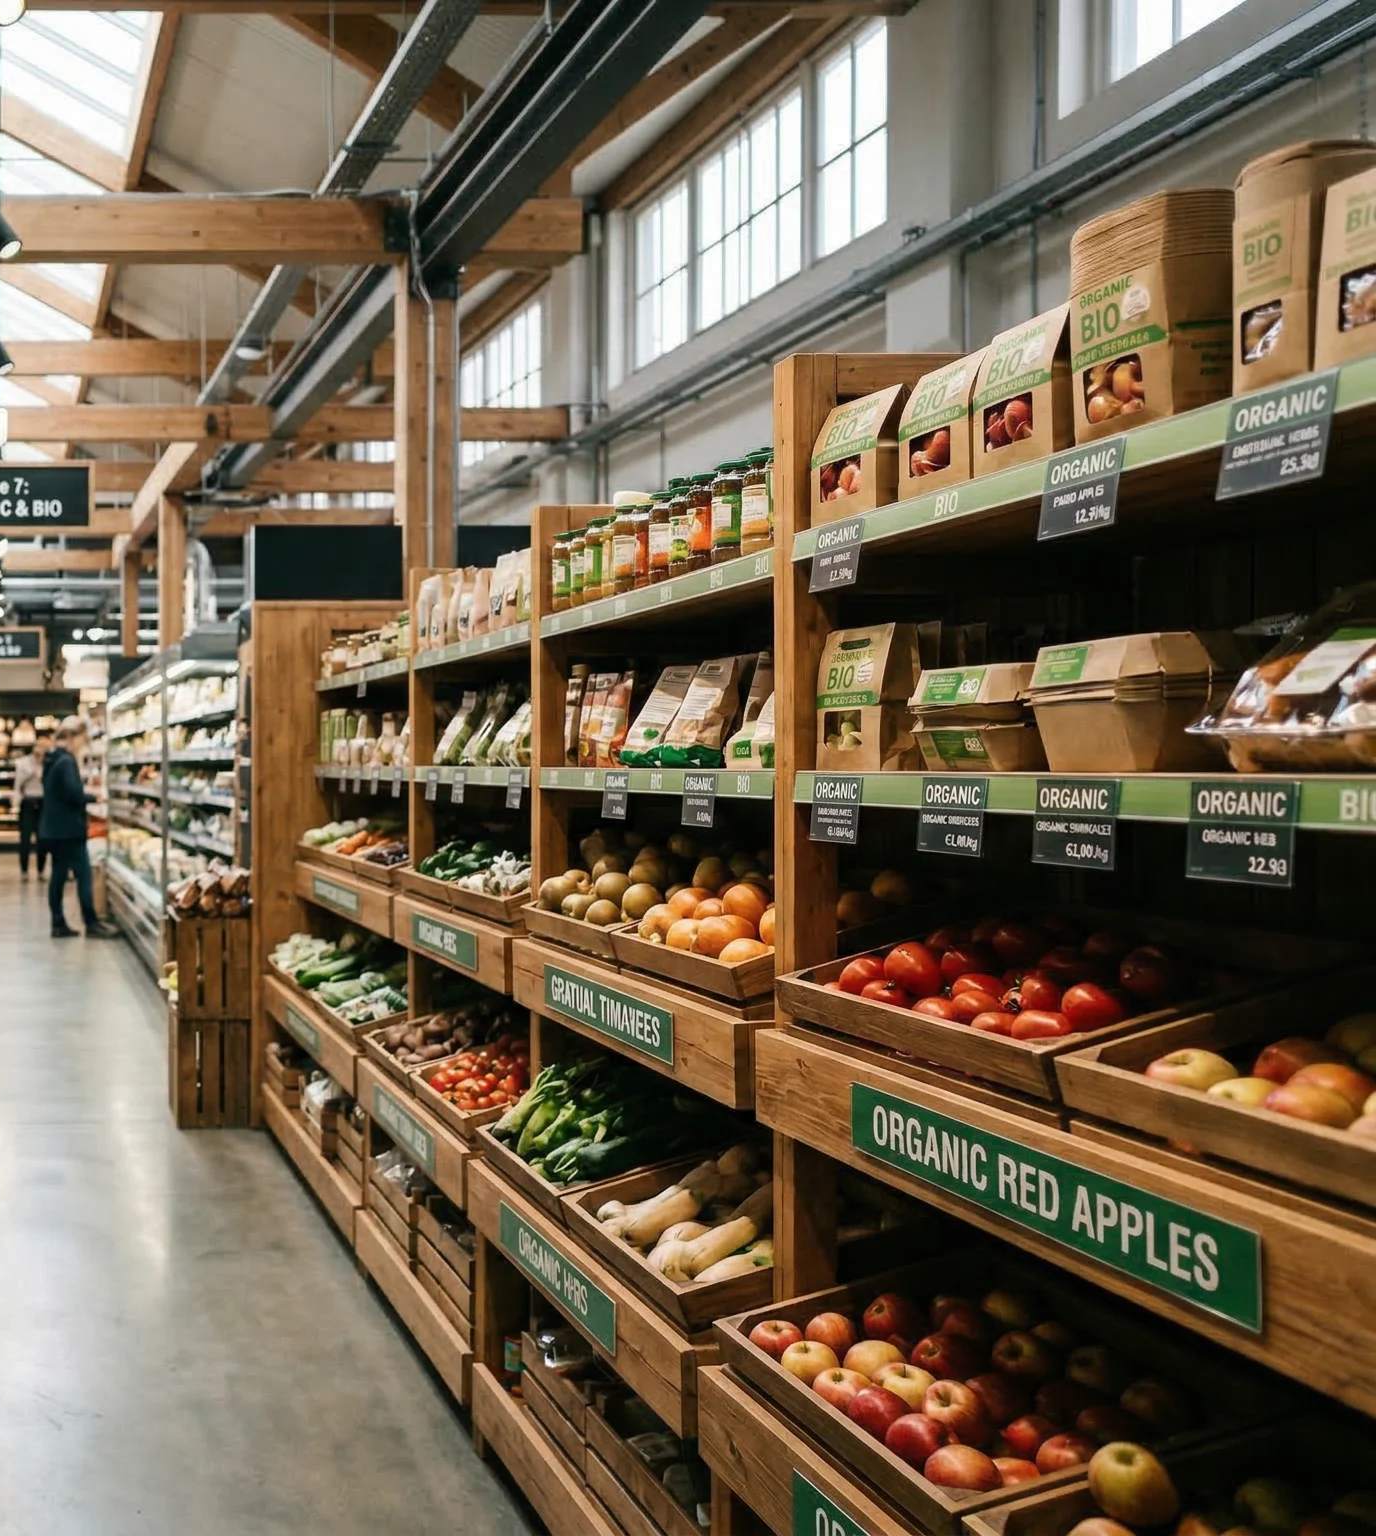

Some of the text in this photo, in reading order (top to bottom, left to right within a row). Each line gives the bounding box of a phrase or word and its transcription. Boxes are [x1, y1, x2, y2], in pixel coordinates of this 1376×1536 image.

[1346, 202, 1376, 233] BI
[1244, 234, 1283, 266] BIO
[1080, 302, 1121, 344] BIO
[986, 349, 1024, 386] BIO
[911, 383, 949, 420] BIO
[1235, 385, 1327, 432] ORGANIC
[824, 418, 858, 448] BIO
[1050, 447, 1117, 485] ORGANIC
[13, 477, 29, 495] 7:
[15, 499, 29, 517] &
[32, 499, 62, 517] BIO
[934, 492, 959, 517] BIO
[826, 665, 855, 690] BIO
[815, 782, 858, 800] ORGANIC
[925, 784, 981, 805] ORGANIC
[1039, 787, 1109, 810] ORGANIC
[1197, 789, 1287, 817] ORGANIC
[551, 974, 597, 1019] GRATUAL
[872, 1105, 1219, 1292] ORGANIC RED APPLES
[518, 1227, 561, 1291] ORGANIC
